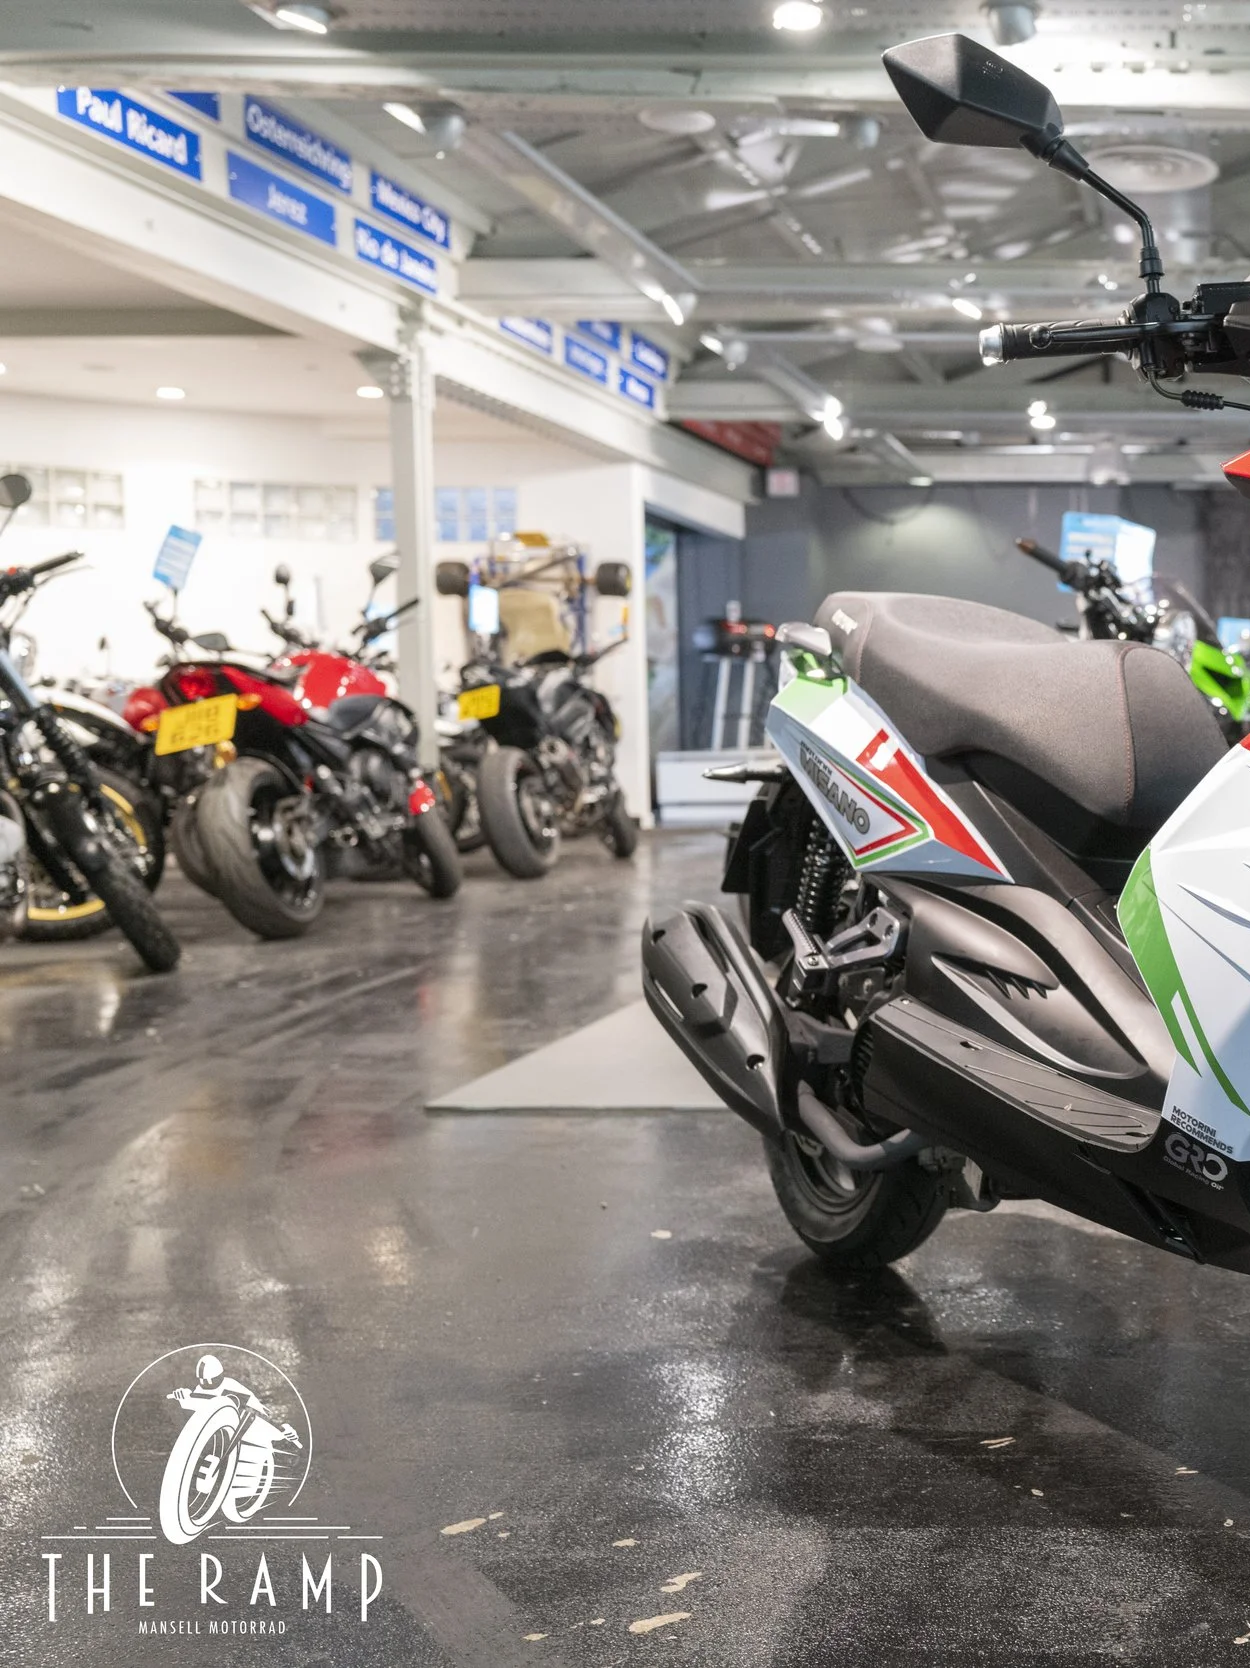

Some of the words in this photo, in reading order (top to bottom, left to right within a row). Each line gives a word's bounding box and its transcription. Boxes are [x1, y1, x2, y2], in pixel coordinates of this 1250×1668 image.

[76, 86, 123, 133] Paul
[126, 108, 188, 166] Ricard
[800, 747, 870, 835] MISANO
[1170, 1114, 1234, 1155] RECOMMENDS
[1171, 1105, 1217, 1137] MOTORINI
[1164, 1131, 1229, 1182] GRO
